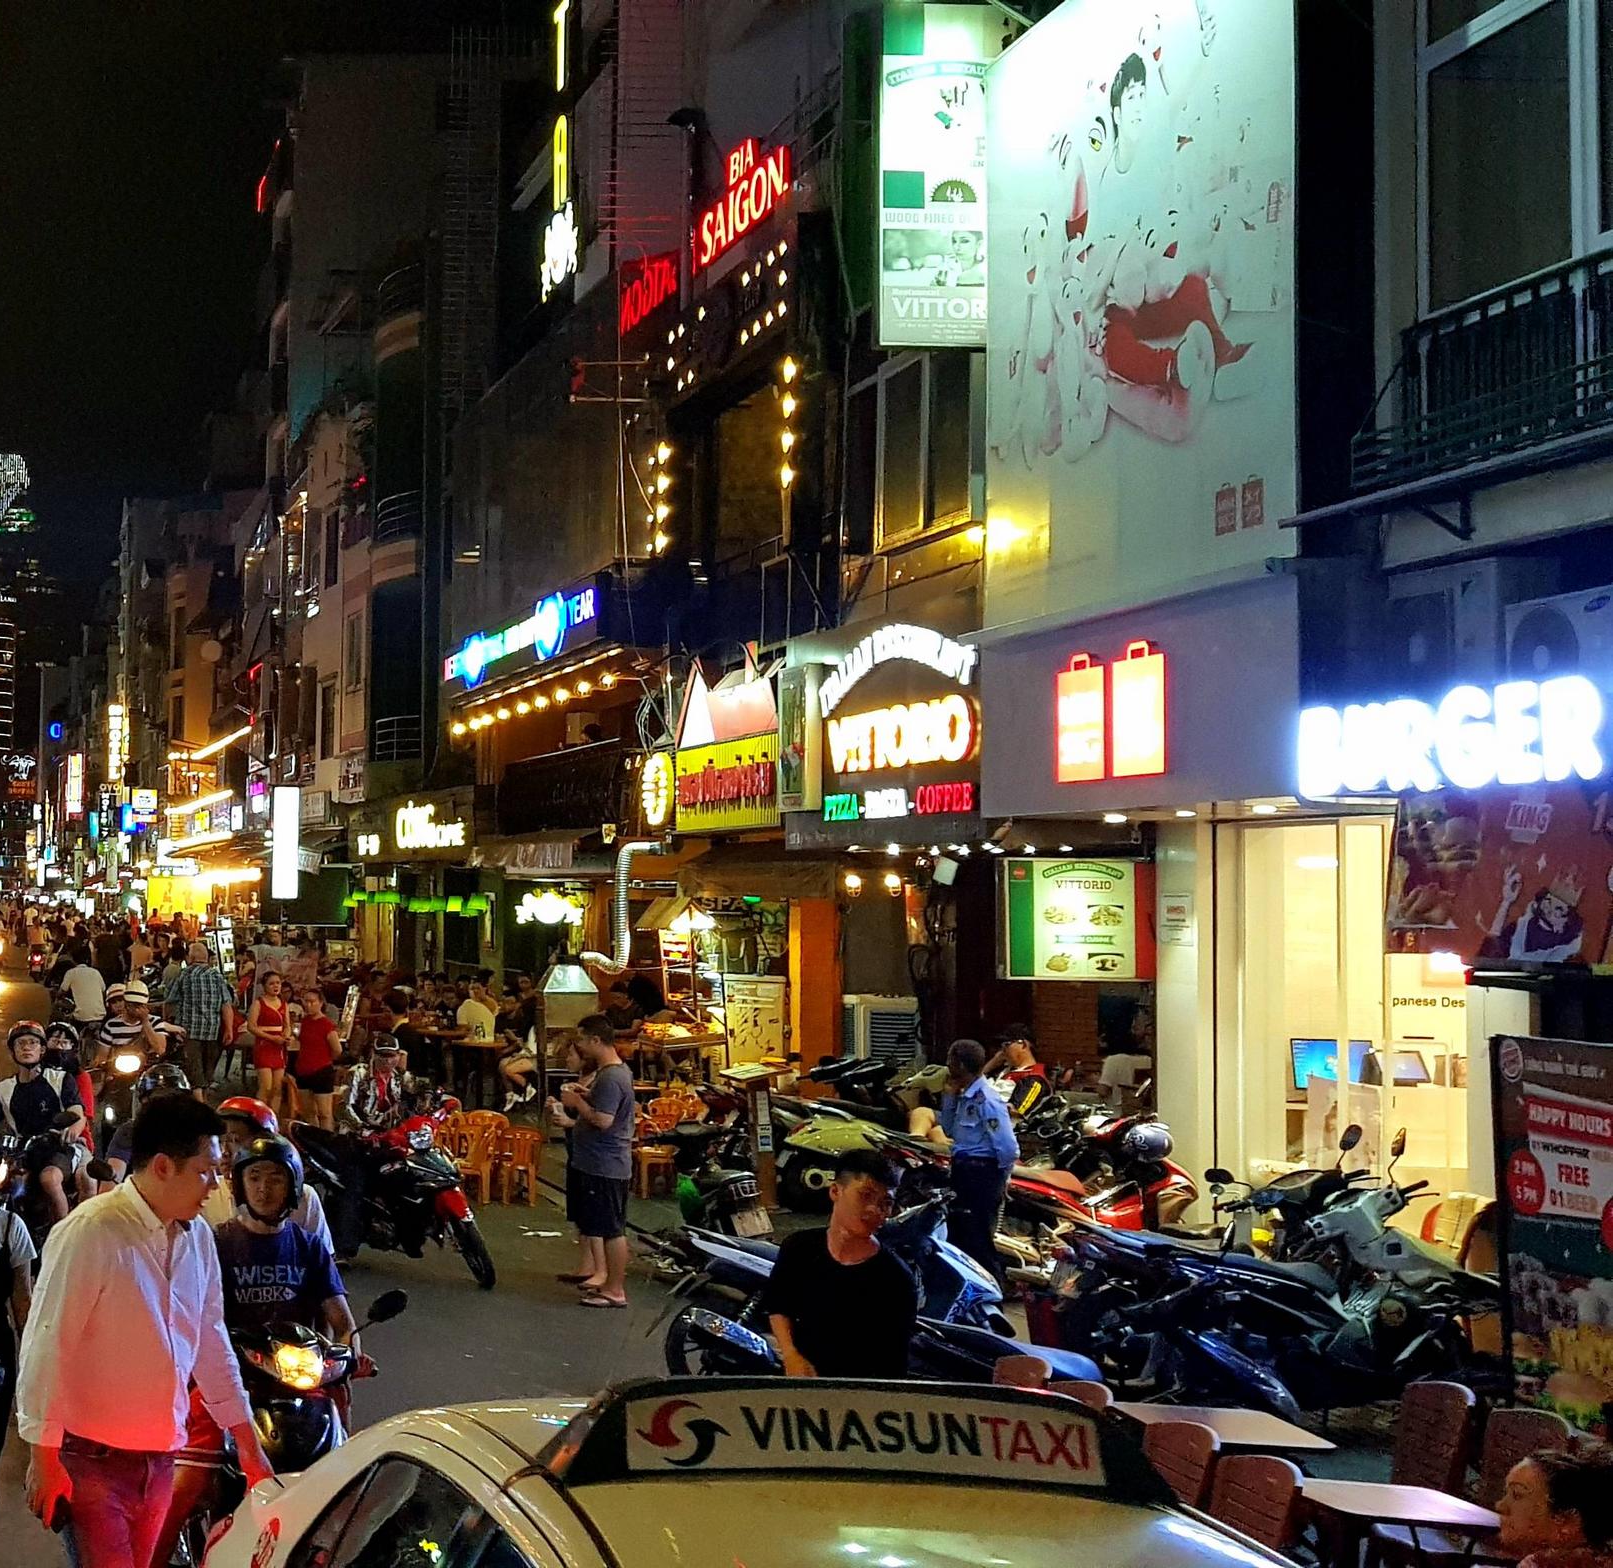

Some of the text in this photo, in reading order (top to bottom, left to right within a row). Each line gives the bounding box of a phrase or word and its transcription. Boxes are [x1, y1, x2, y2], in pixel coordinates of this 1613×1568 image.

[729, 138, 754, 186] BIA
[828, 694, 972, 773] VITTORIO
[1297, 674, 1604, 799] BURGER
[824, 794, 859, 821] PIZZA
[916, 782, 972, 814] COFFEE
[1055, 879, 1112, 890] VITTORIO
[1392, 996, 1465, 1008] panese Des
[1528, 1102, 1612, 1138] HAPPY HOURS
[1557, 1162, 1591, 1187] FREE
[233, 1264, 306, 1286] WISELY
